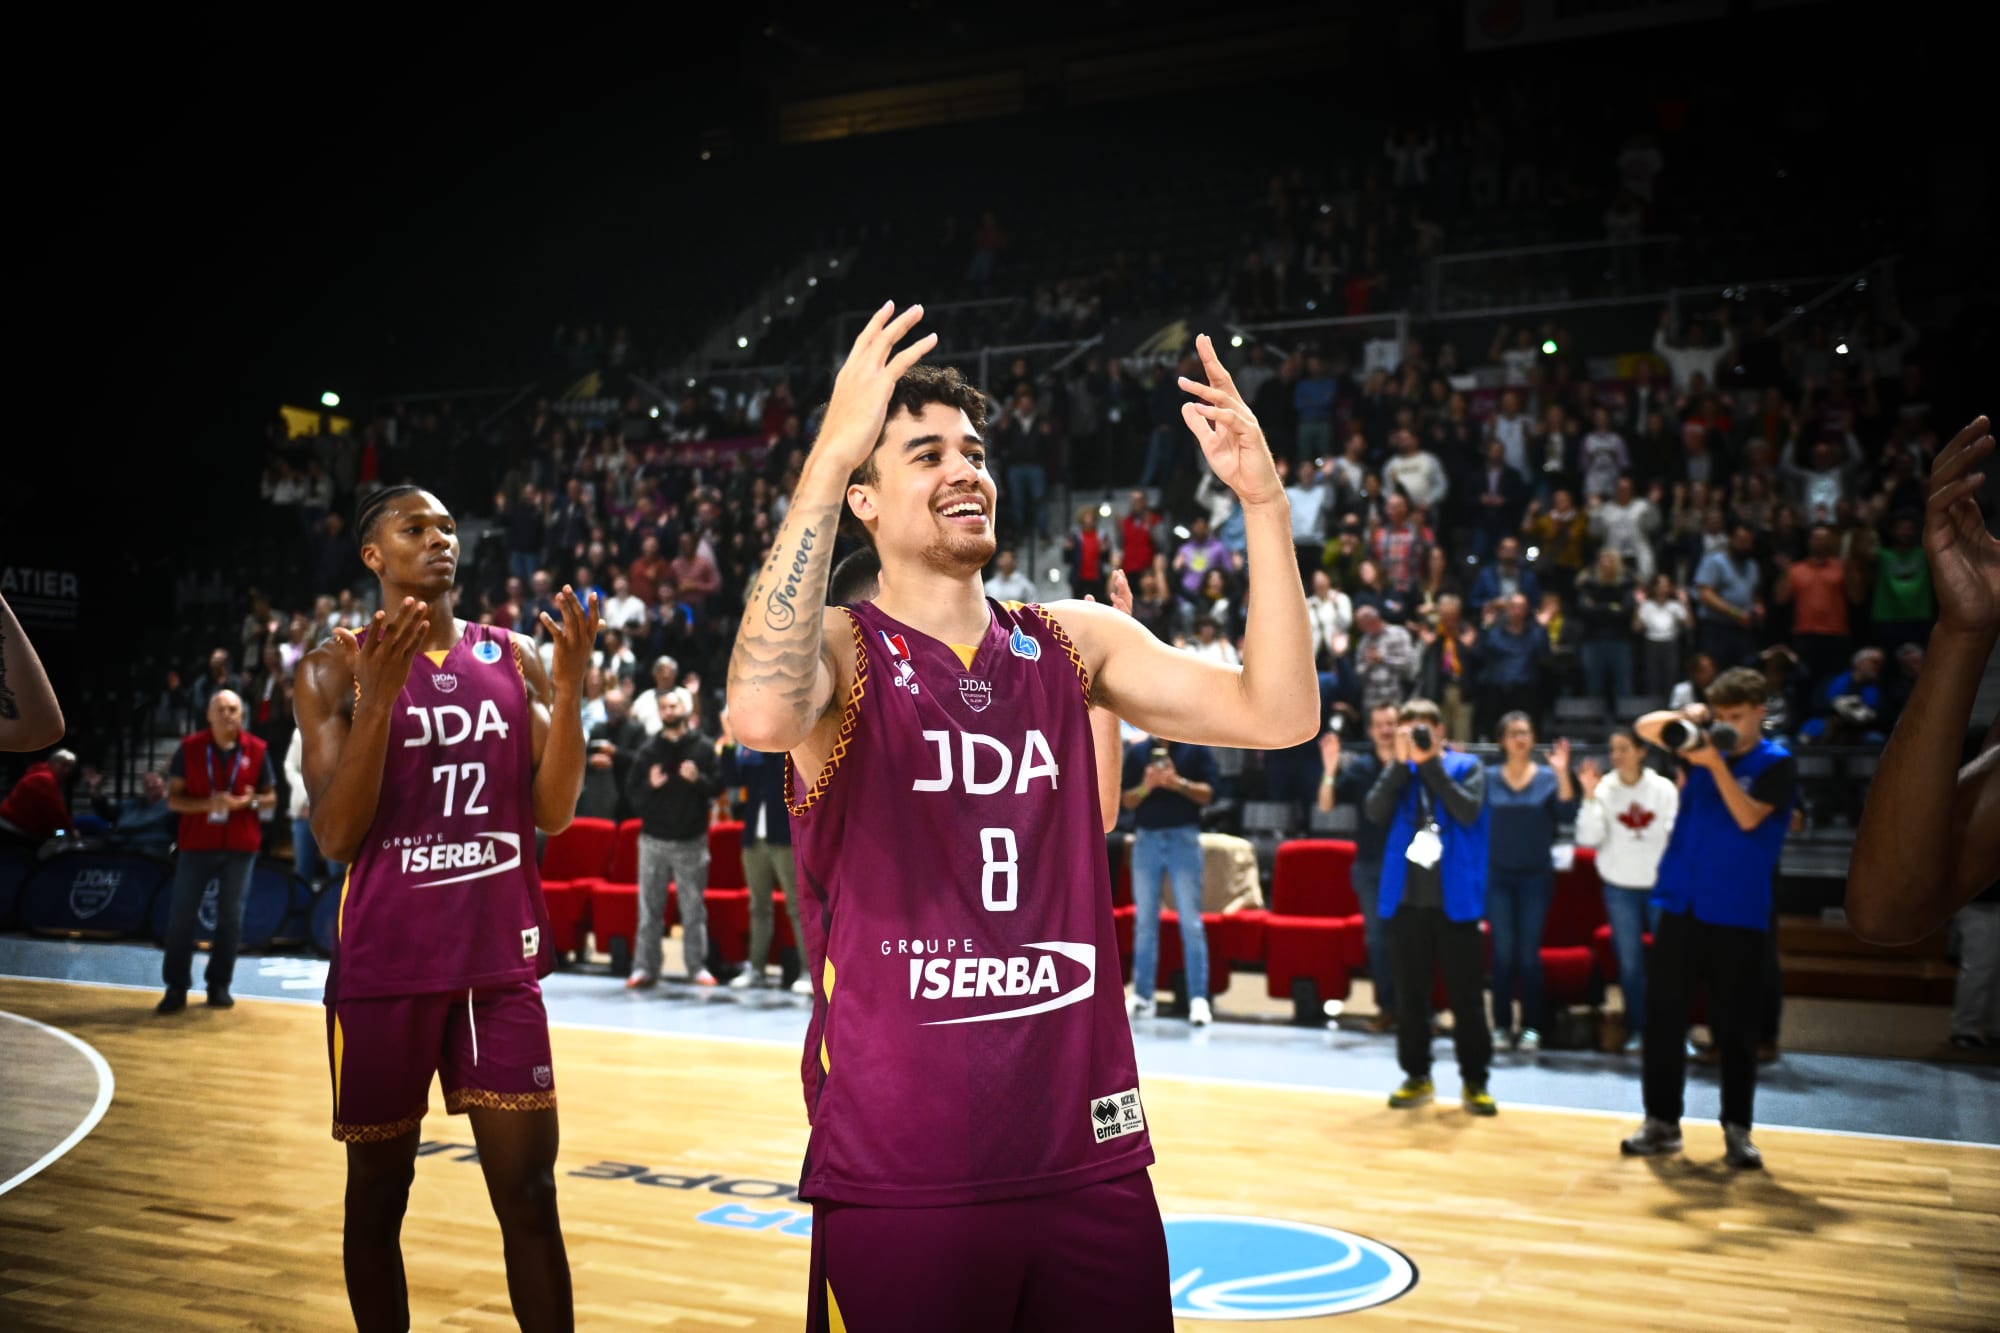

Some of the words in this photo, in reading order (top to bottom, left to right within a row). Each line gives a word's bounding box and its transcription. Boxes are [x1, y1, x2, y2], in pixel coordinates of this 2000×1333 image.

[404, 700, 509, 747] JDA
[912, 730, 1059, 795] JDA
[432, 762, 489, 817] 72
[383, 832, 443, 849] GROUPE
[980, 828, 1018, 911] 8
[881, 939, 972, 955] GROUPE
[1096, 1122, 1121, 1139] errea
[1123, 1108, 1137, 1121] XL
